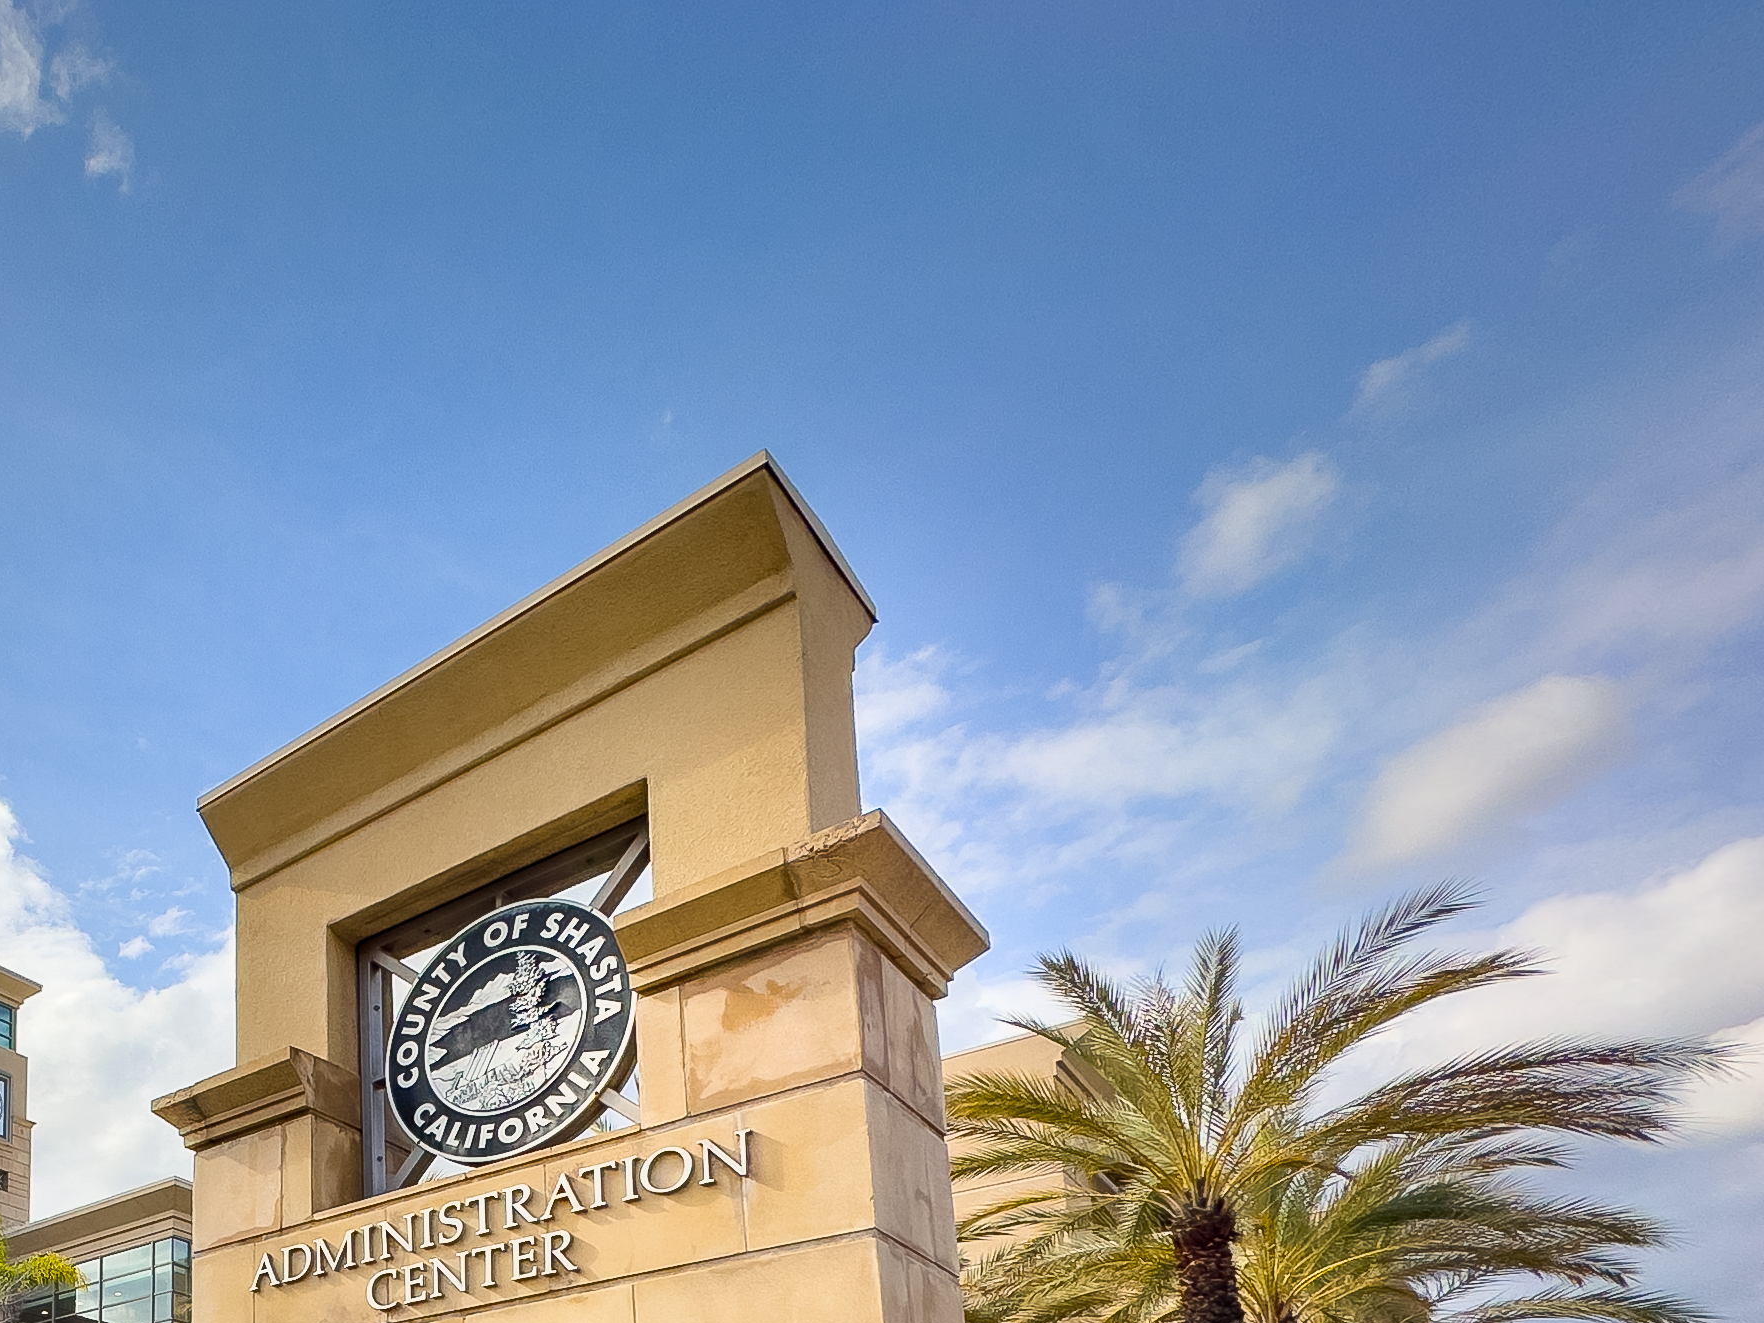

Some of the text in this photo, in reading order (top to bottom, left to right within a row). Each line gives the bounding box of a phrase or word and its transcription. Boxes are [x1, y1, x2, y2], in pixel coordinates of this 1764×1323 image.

[397, 912, 622, 1088] COUNTY OF SHASTA
[413, 1049, 610, 1149] CALIFORNIA
[250, 1129, 754, 1292] ADMINISTRATION
[366, 1229, 580, 1311] CENTER
